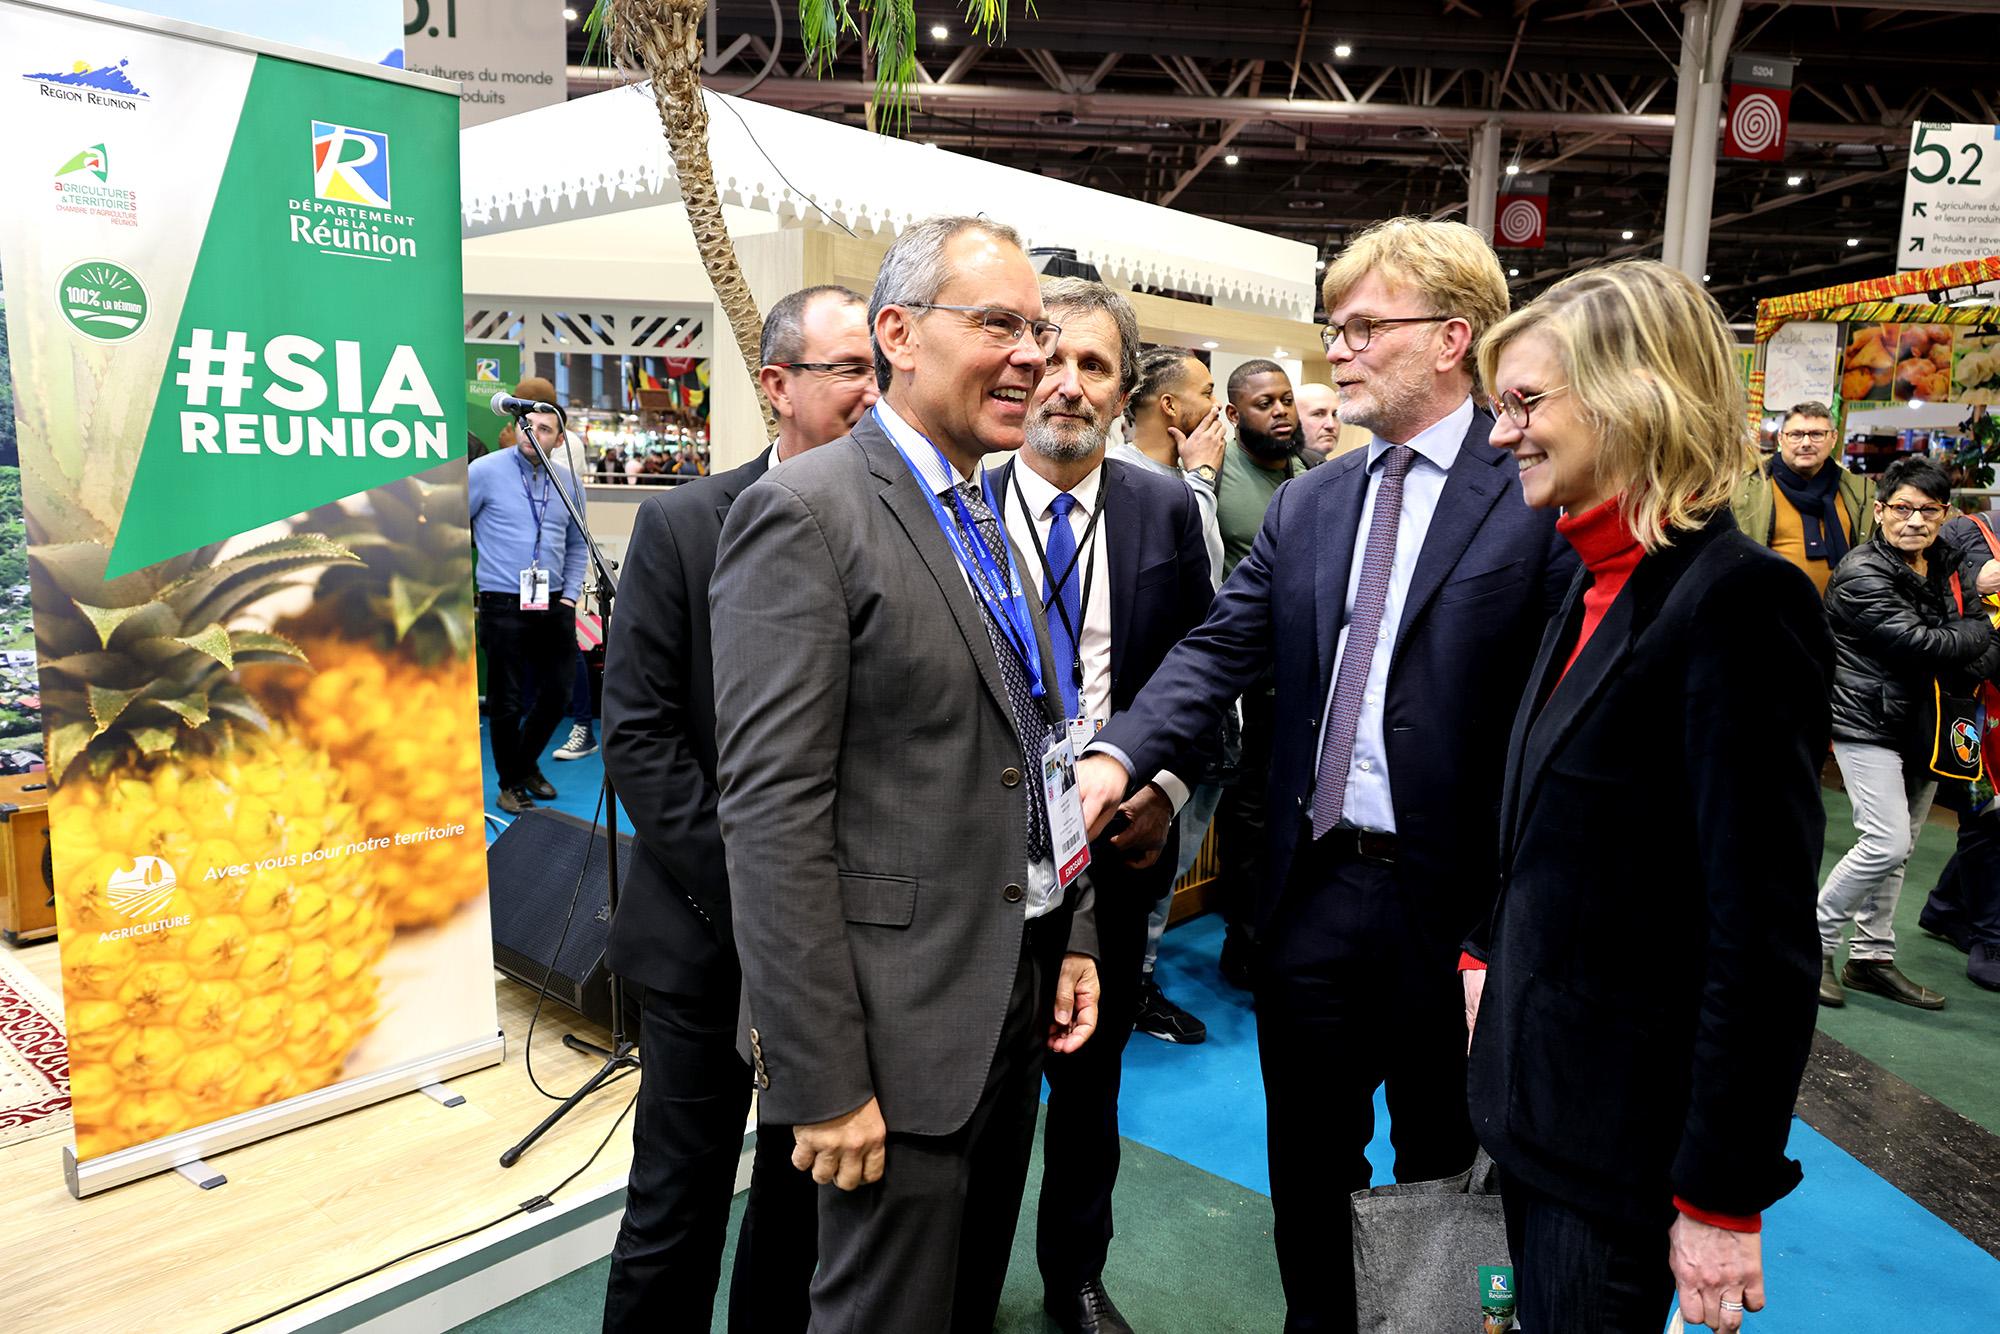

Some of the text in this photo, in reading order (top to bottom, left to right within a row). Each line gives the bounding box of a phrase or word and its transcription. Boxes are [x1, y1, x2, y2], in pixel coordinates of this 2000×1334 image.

[478, 67, 497, 82] du
[502, 70, 553, 85] monde
[40, 83, 136, 111] REGION REUNION
[461, 89, 505, 104] oduits
[1921, 122, 1951, 130] PAVILLON
[1910, 124, 1984, 186] 5.2
[69, 195, 137, 211] TERRITOIRES
[288, 198, 415, 226] DÉPARTEMENT
[290, 214, 417, 258] Réunion
[334, 217, 367, 230] DE LA
[66, 286, 101, 307] 100%
[176, 328, 444, 417] #SIA
[180, 411, 449, 459] REUNION
[203, 823, 465, 882] Avec vous pour notre territoire
[98, 914, 191, 944] AGRICULTURE
